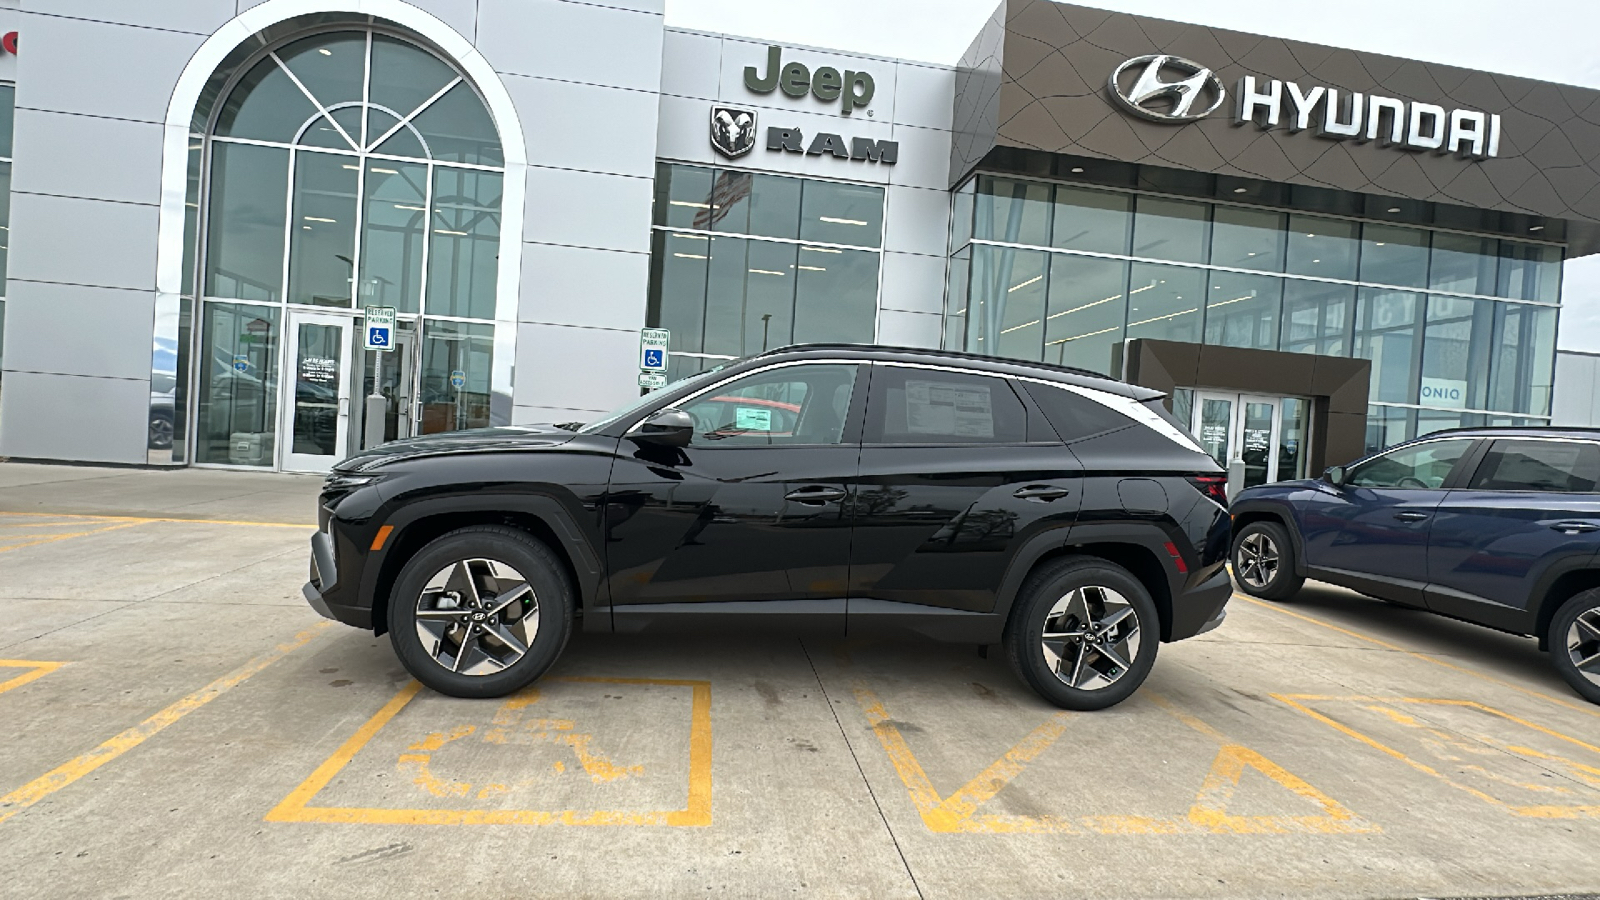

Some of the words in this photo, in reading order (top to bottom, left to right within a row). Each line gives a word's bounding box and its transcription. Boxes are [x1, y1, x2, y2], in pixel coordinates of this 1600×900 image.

[744, 45, 875, 115] Jeep
[767, 126, 899, 165] RAM
[1236, 75, 1500, 159] HYUNDAI
